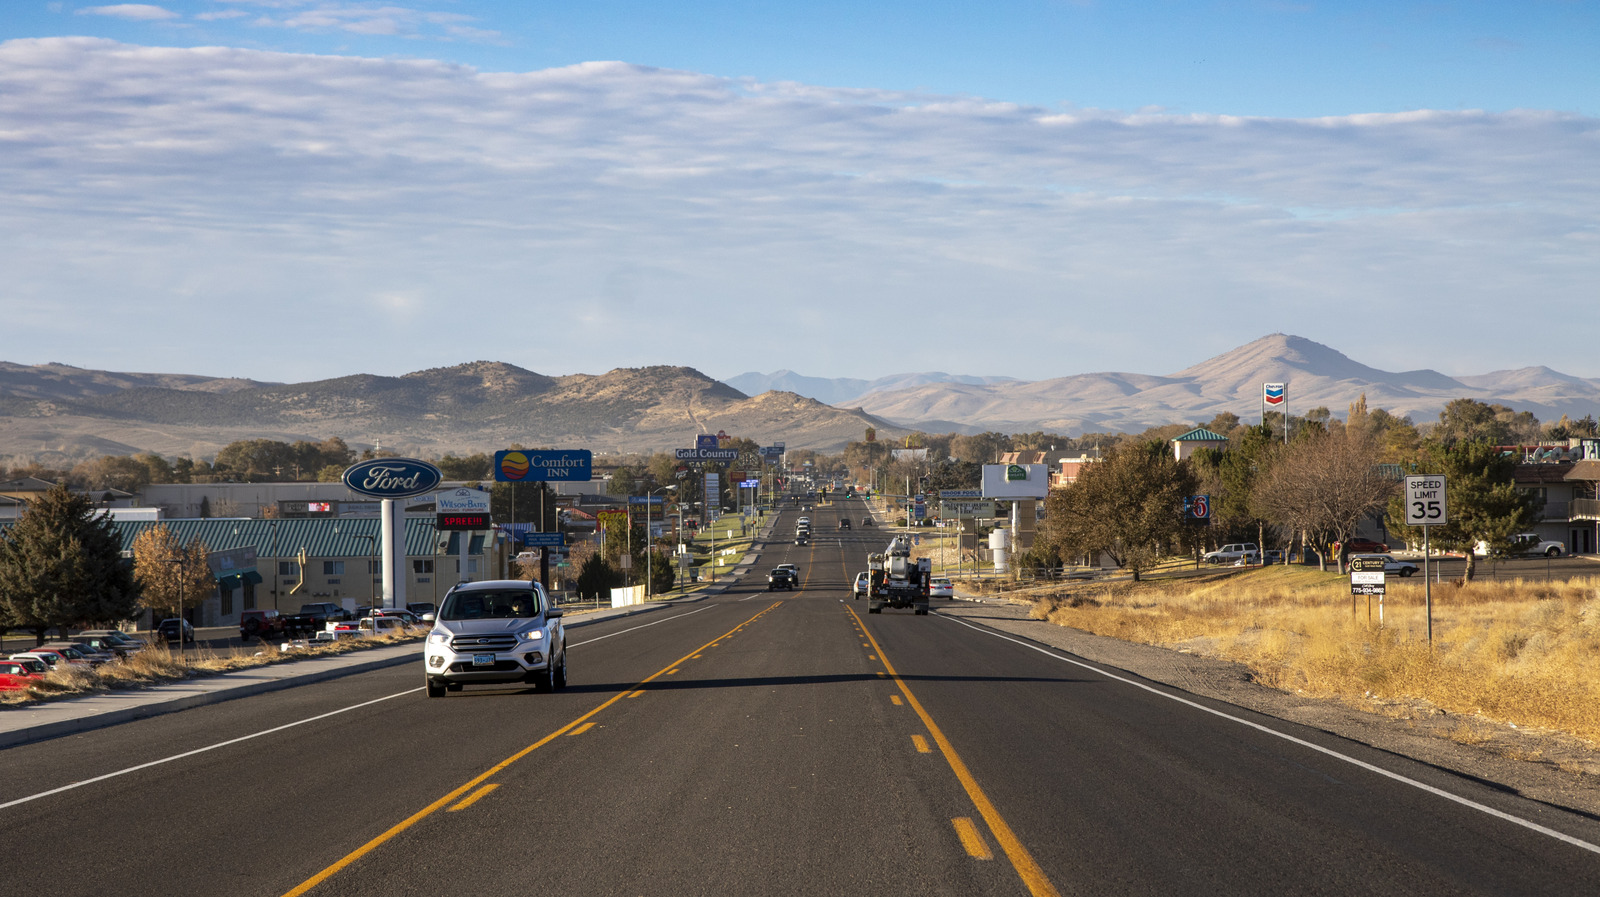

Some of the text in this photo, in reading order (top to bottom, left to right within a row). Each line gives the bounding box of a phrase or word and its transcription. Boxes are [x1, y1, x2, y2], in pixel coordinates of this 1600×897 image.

[676, 448, 738, 460] Gold Country
[531, 454, 584, 468] Comfort
[363, 466, 420, 490] Ford
[547, 468, 569, 478] INN
[1410, 480, 1442, 489] SPEED
[1193, 496, 1208, 518] 6
[1412, 501, 1442, 519] 35
[444, 517, 482, 526] SPREE!!!
